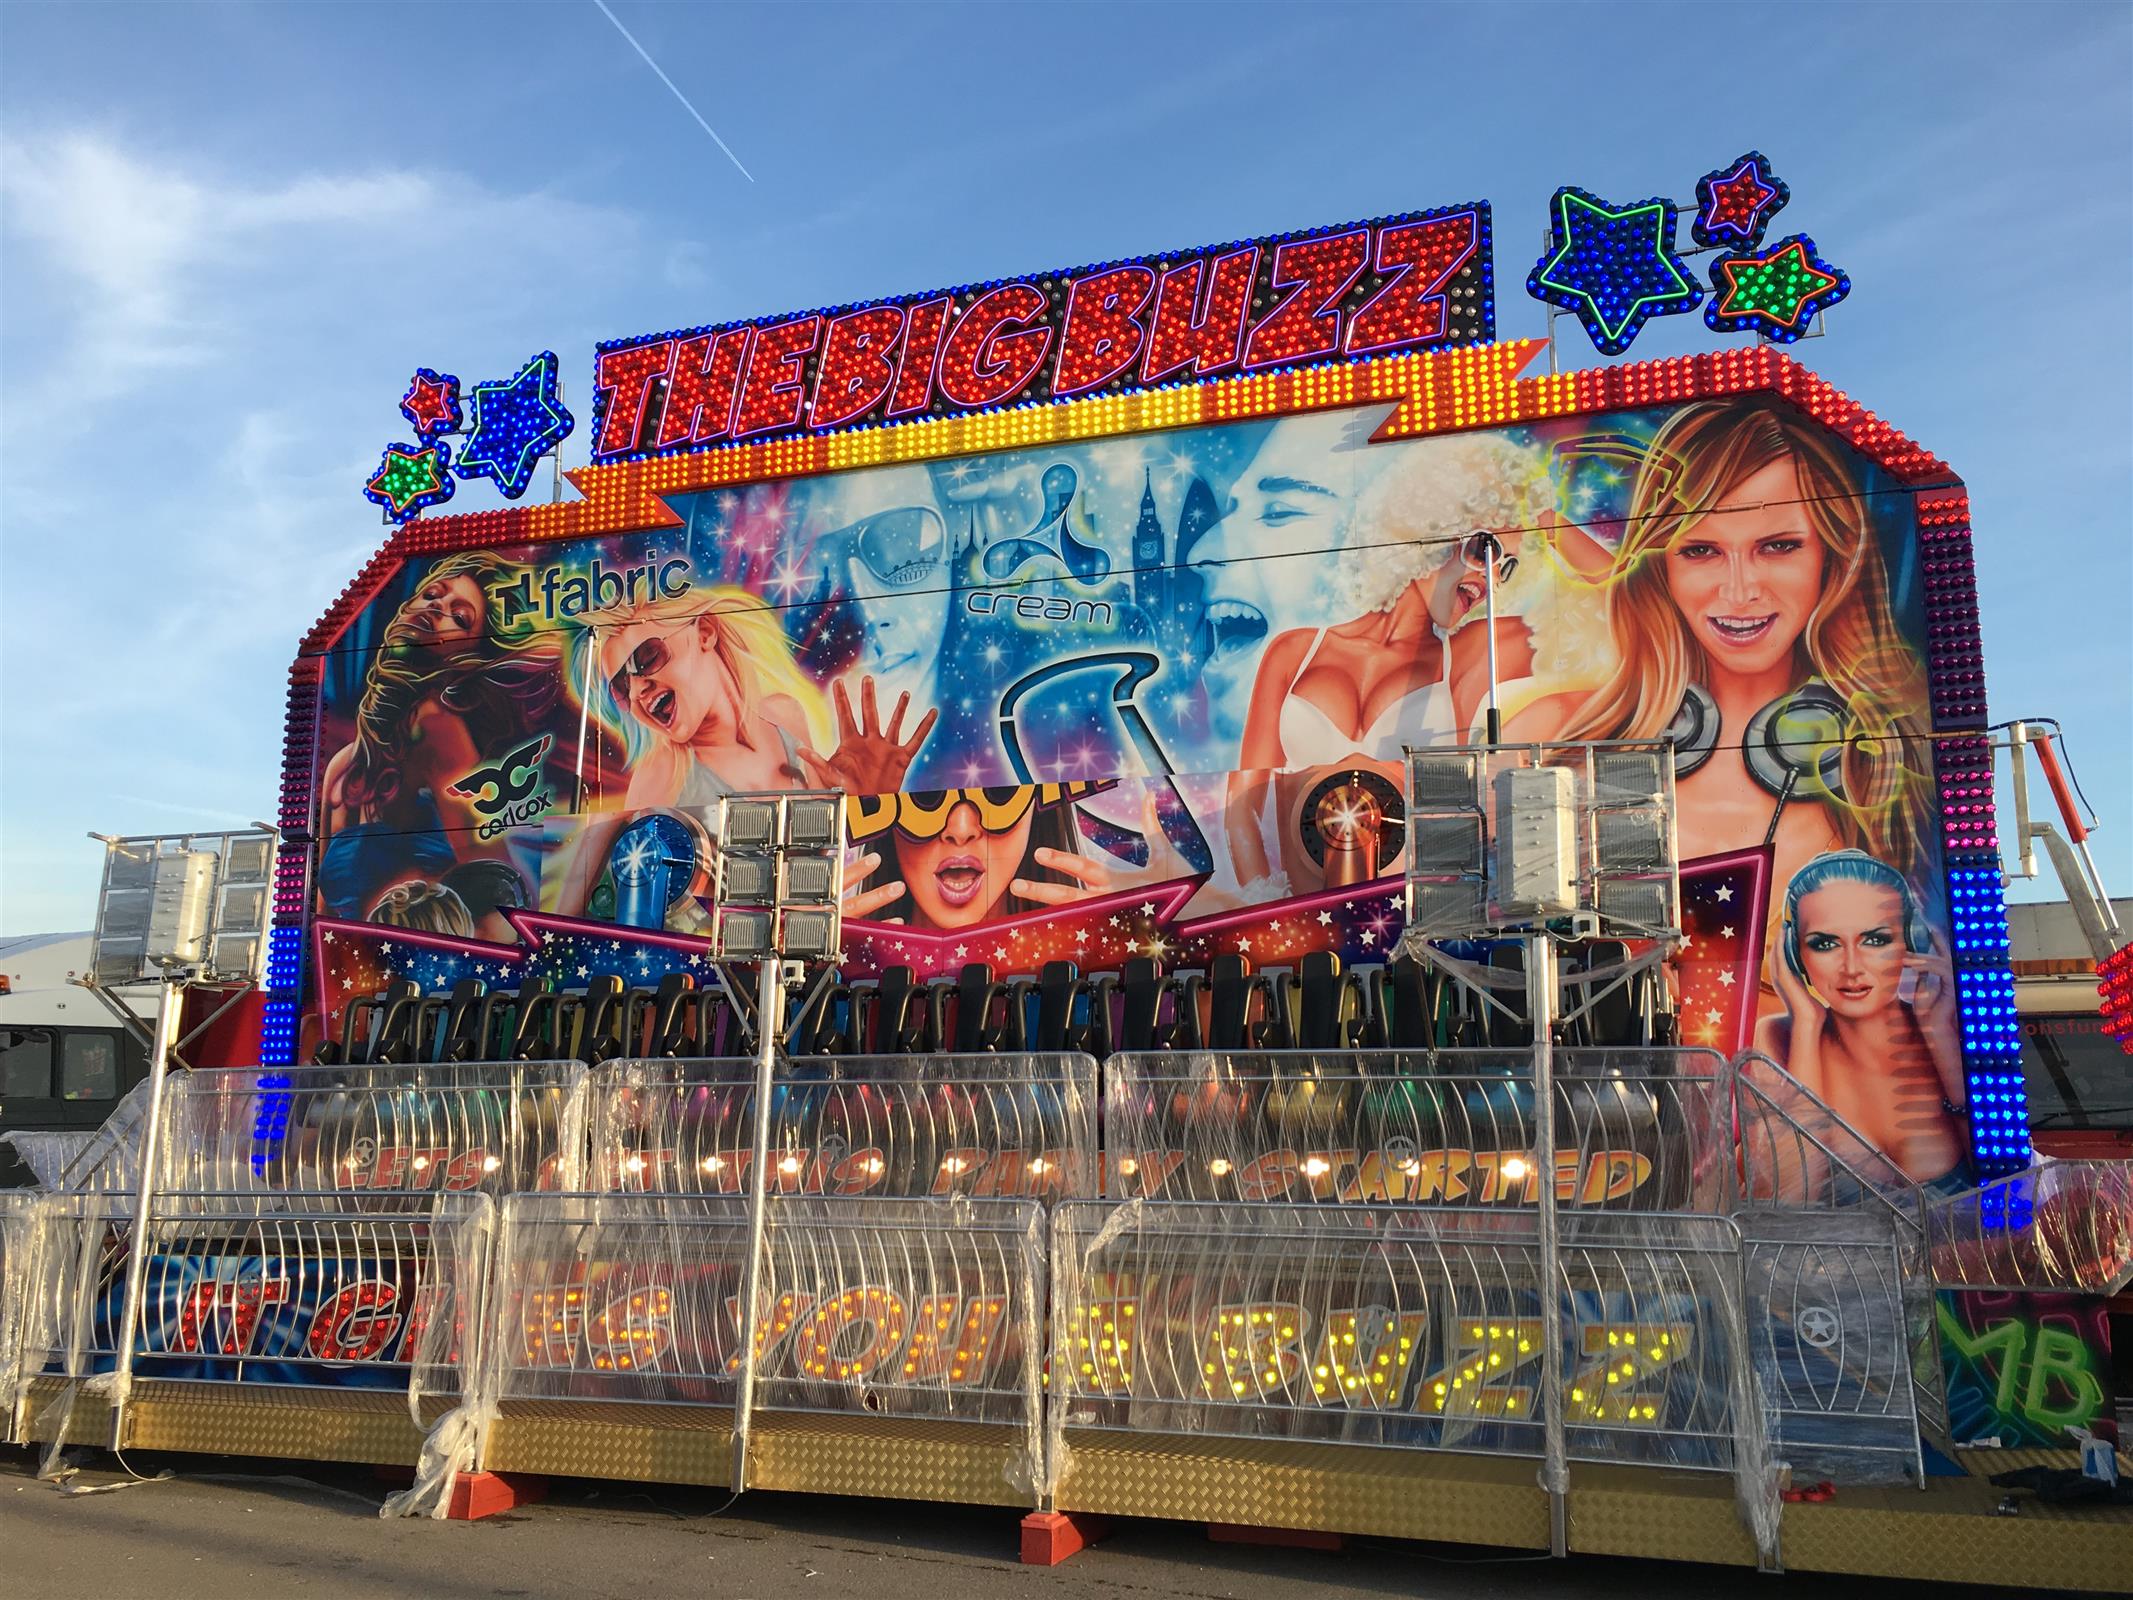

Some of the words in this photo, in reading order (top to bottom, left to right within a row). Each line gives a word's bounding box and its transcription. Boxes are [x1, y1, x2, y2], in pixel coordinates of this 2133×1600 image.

[541, 549, 693, 620] fabric
[967, 592, 1112, 625] cream
[537, 1148, 675, 1193] GT
[1240, 1148, 1653, 1204] STARTED
[723, 1284, 1009, 1387] YOU
[1191, 1301, 1695, 1428] BUZZ
